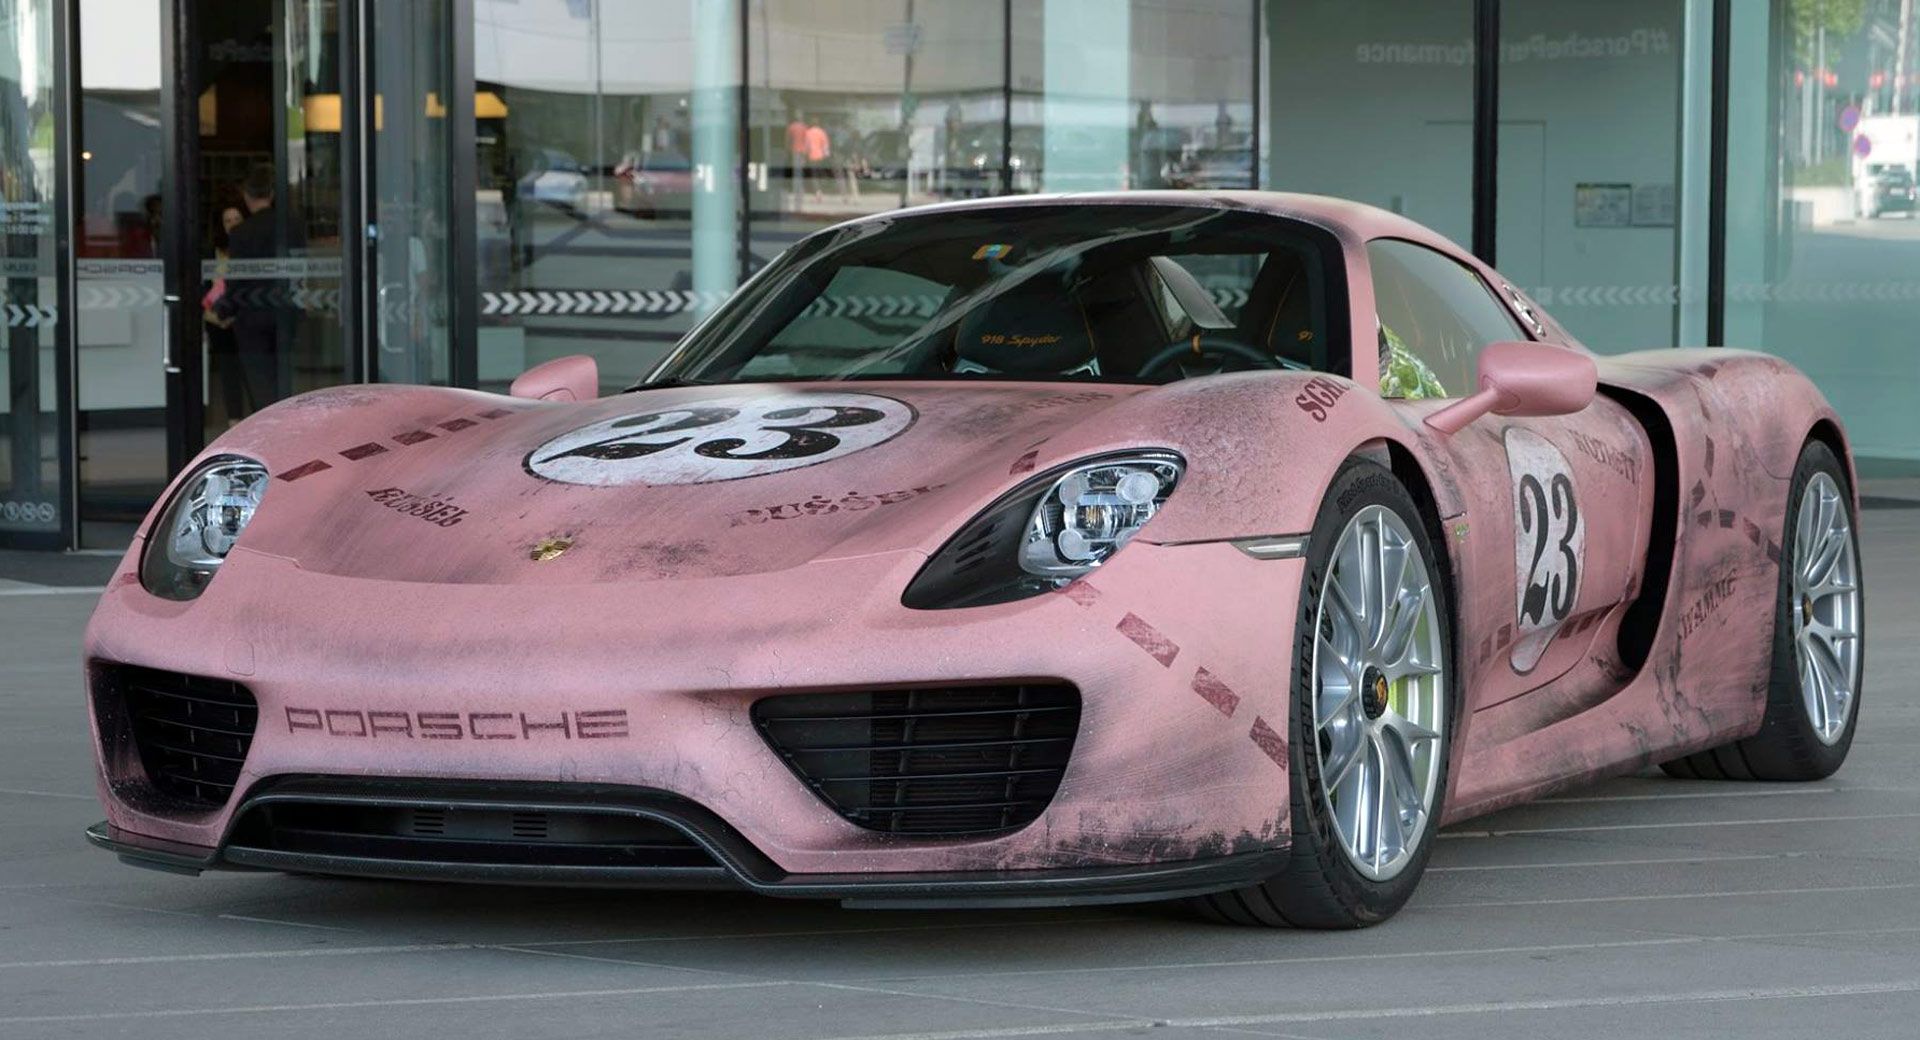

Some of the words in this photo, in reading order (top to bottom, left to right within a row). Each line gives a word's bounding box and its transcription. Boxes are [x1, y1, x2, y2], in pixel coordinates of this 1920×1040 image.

[981, 333, 1005, 345] 918
[1008, 333, 1063, 348] Spyder
[534, 405, 886, 464] 23
[1518, 472, 1579, 626] 23
[284, 705, 630, 740] PORSCHE
